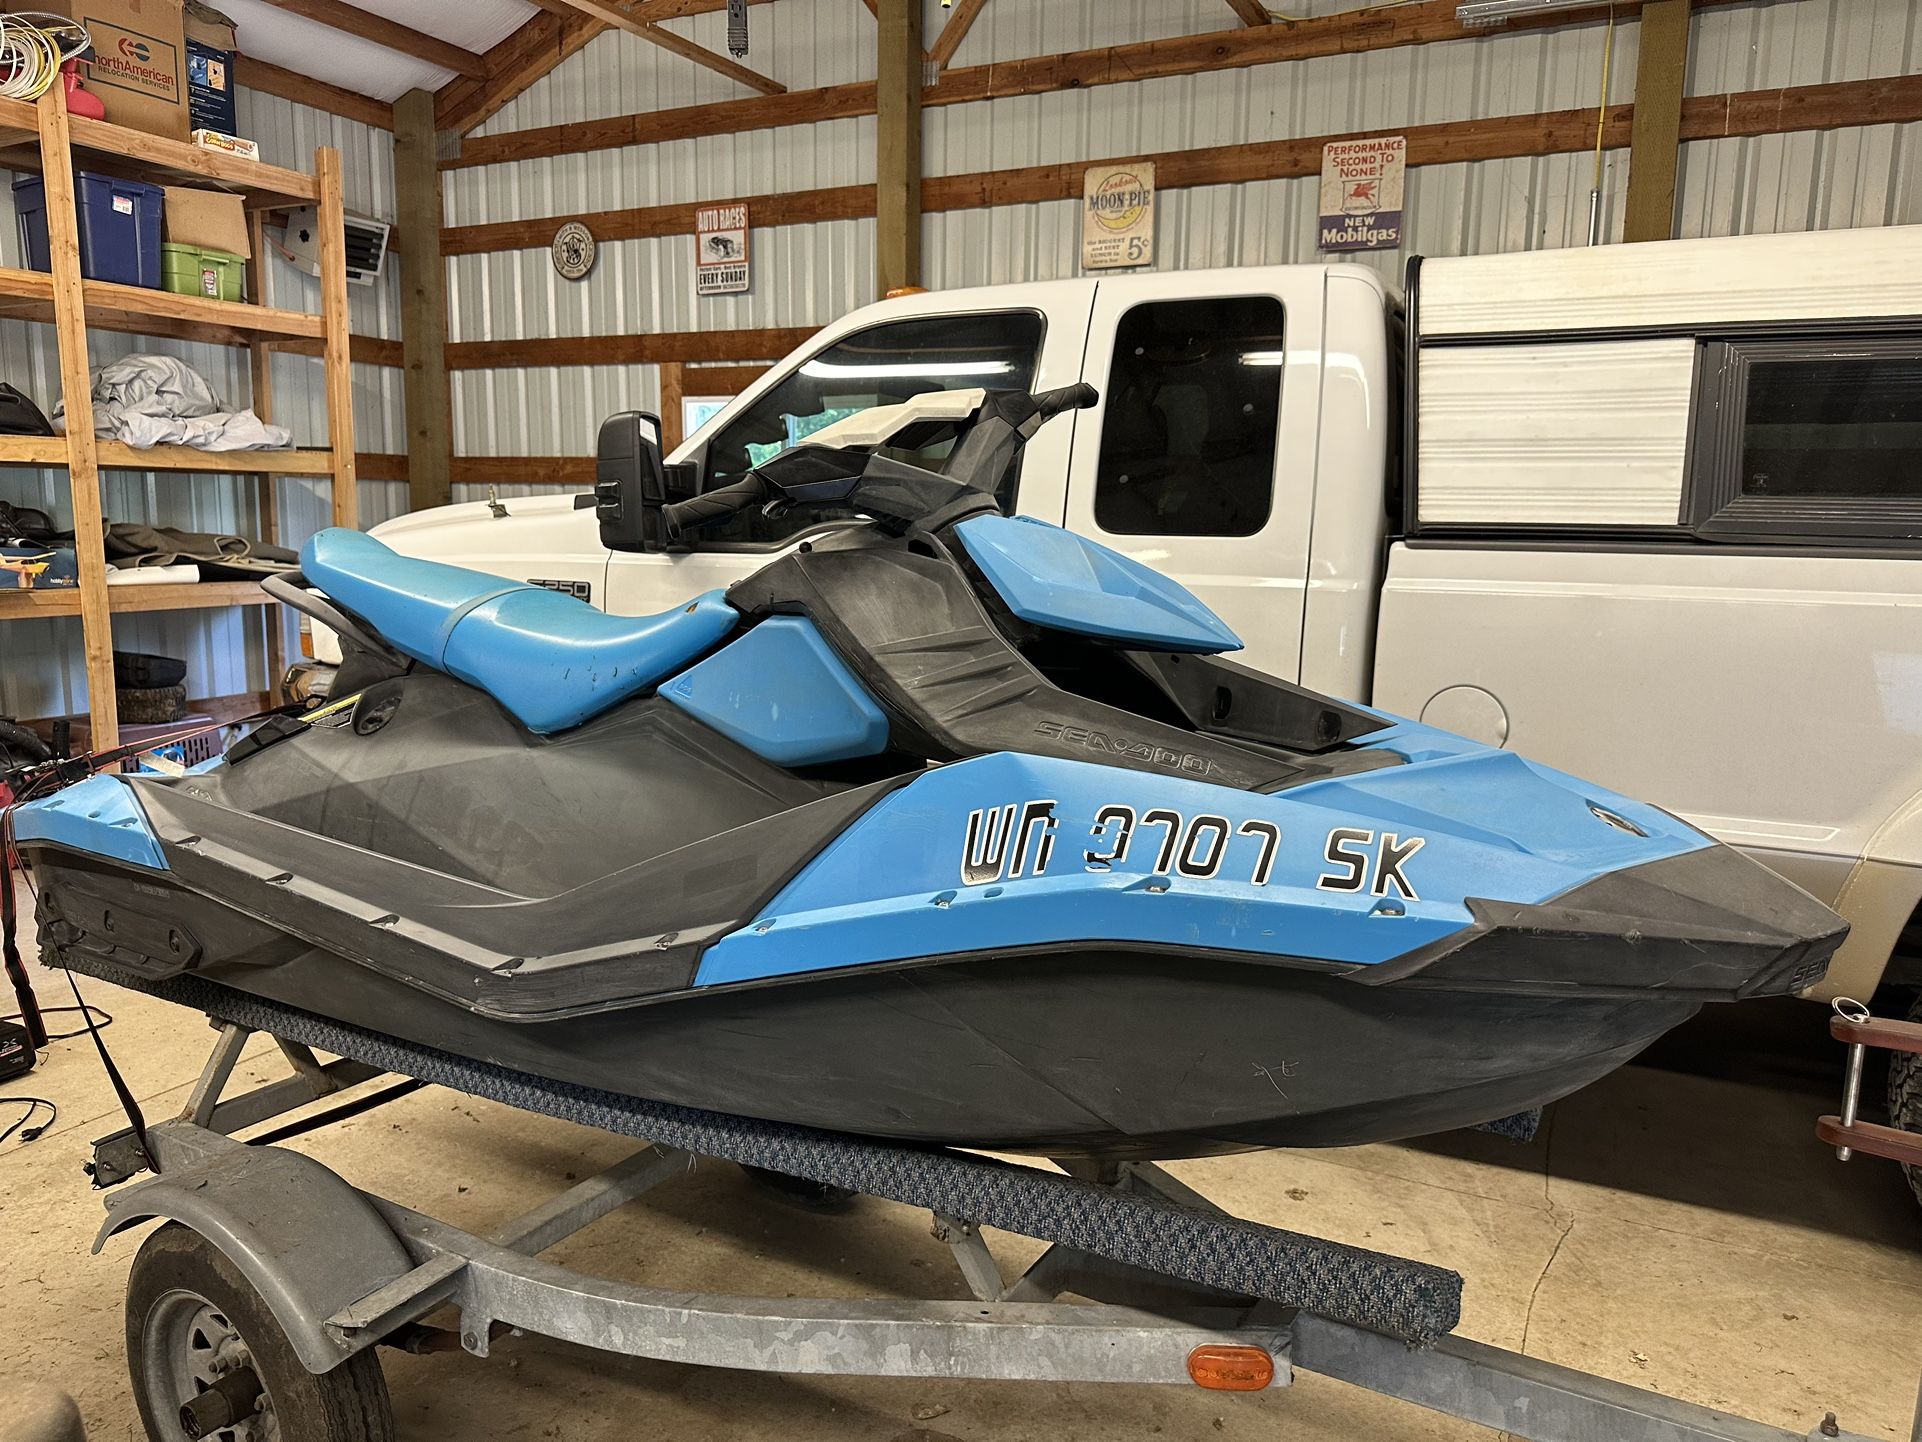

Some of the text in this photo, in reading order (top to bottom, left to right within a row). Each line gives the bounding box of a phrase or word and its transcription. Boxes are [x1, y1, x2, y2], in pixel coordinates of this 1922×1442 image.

[95, 55, 174, 86] northAmerican
[98, 66, 170, 92] RELOCATION SERVICES
[1327, 140, 1403, 156] PERFORMANCE
[1332, 152, 1395, 168] SECOND TO
[698, 207, 746, 232] AUTO RACES
[1344, 216, 1376, 227] NEW
[1321, 226, 1397, 246] Mobilgas
[699, 270, 746, 285] EVERY SUNDAY
[1315, 826, 1426, 902] SK
